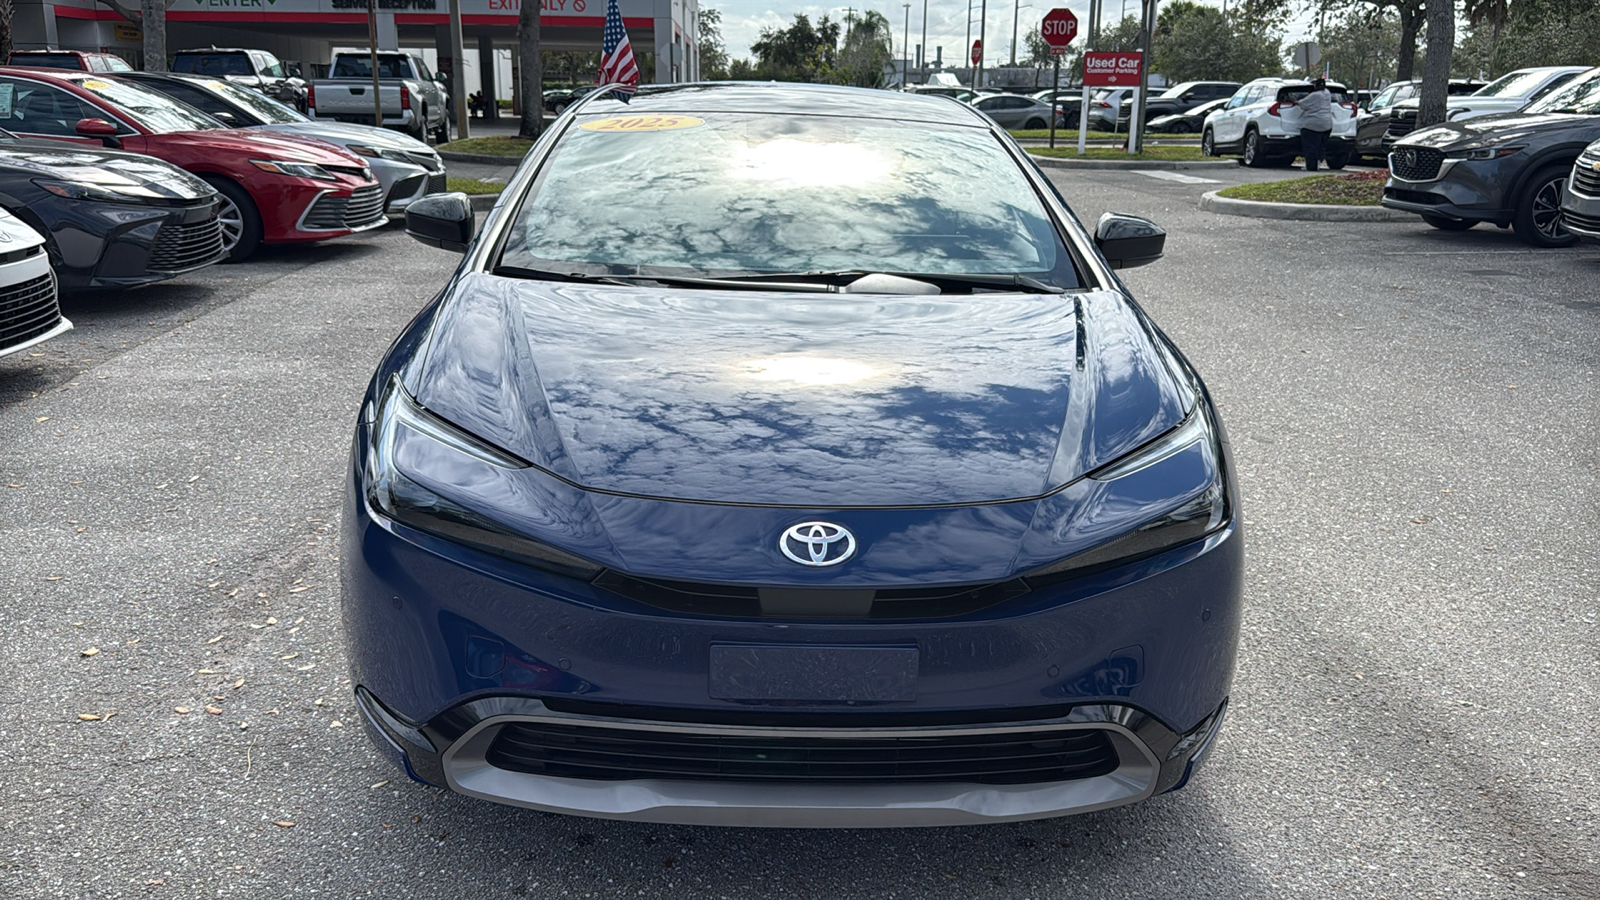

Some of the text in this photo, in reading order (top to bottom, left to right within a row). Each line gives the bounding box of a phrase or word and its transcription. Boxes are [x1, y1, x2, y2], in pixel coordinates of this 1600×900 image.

[378, 0, 436, 10] RECEPTION
[489, 0, 519, 10] EXIT
[1043, 20, 1076, 35] STOP
[1086, 57, 1139, 68] Used Car
[597, 117, 684, 130] 2025
